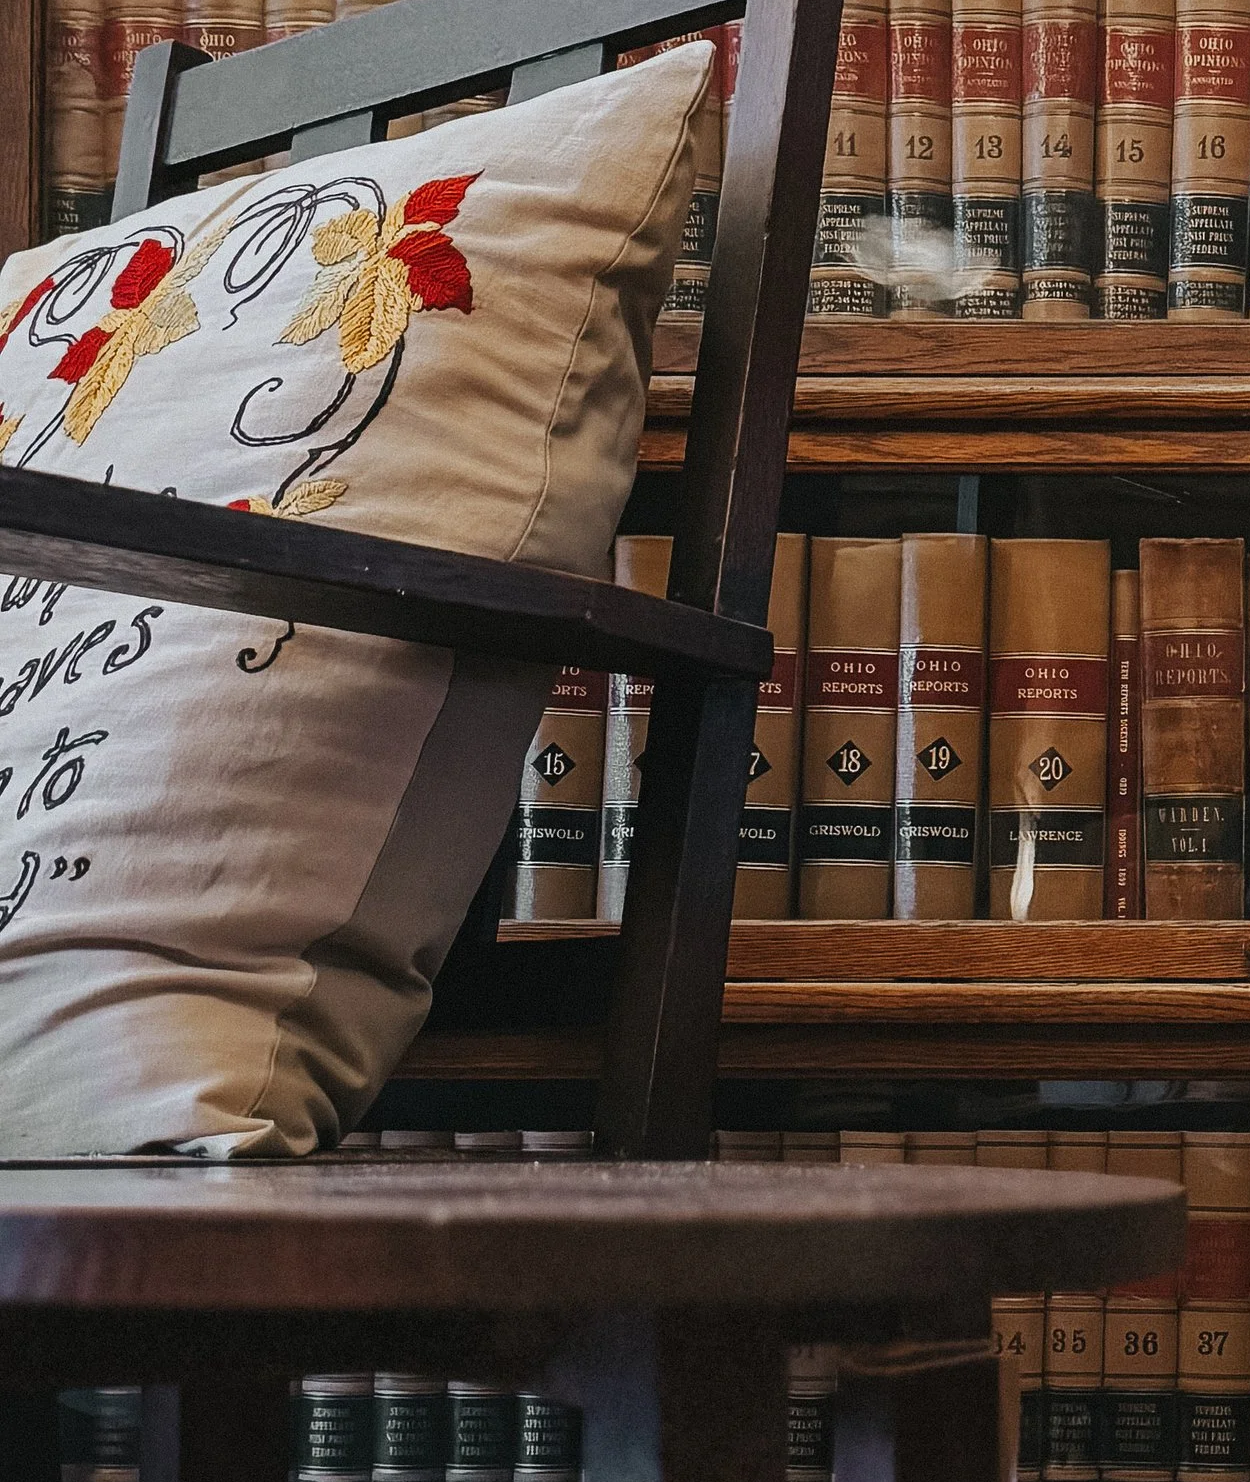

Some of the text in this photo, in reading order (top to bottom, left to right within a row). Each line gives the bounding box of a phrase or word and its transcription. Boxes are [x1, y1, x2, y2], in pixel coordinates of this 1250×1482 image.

[973, 38, 1008, 53] OHIO
[1199, 37, 1233, 51] OHIO
[1184, 53, 1245, 69] OPINIONS
[834, 133, 858, 157] 11
[905, 135, 934, 160] 12
[975, 135, 1002, 159] 13
[1040, 134, 1072, 158] 14
[1116, 139, 1144, 163] 15
[1198, 135, 1226, 159] 16
[830, 661, 876, 675] OHIO
[916, 660, 962, 673] OHIO
[1025, 667, 1070, 679] OHIO
[552, 683, 588, 697] ORTS
[822, 681, 884, 695] REPORTS
[909, 679, 969, 693] REPORTS
[1017, 687, 1078, 701] REPORTS
[543, 752, 565, 776] 15
[750, 752, 761, 776] 7
[838, 749, 862, 773] 18
[928, 745, 950, 770] 19
[1038, 756, 1064, 781] 20
[809, 825, 881, 837] GRISWOLD
[900, 825, 969, 839] GRISWOLD
[1009, 830, 1084, 843] LAWRENCE
[1052, 1327, 1086, 1355] 35
[1124, 1331, 1158, 1356] 36
[1197, 1331, 1229, 1356] 37
